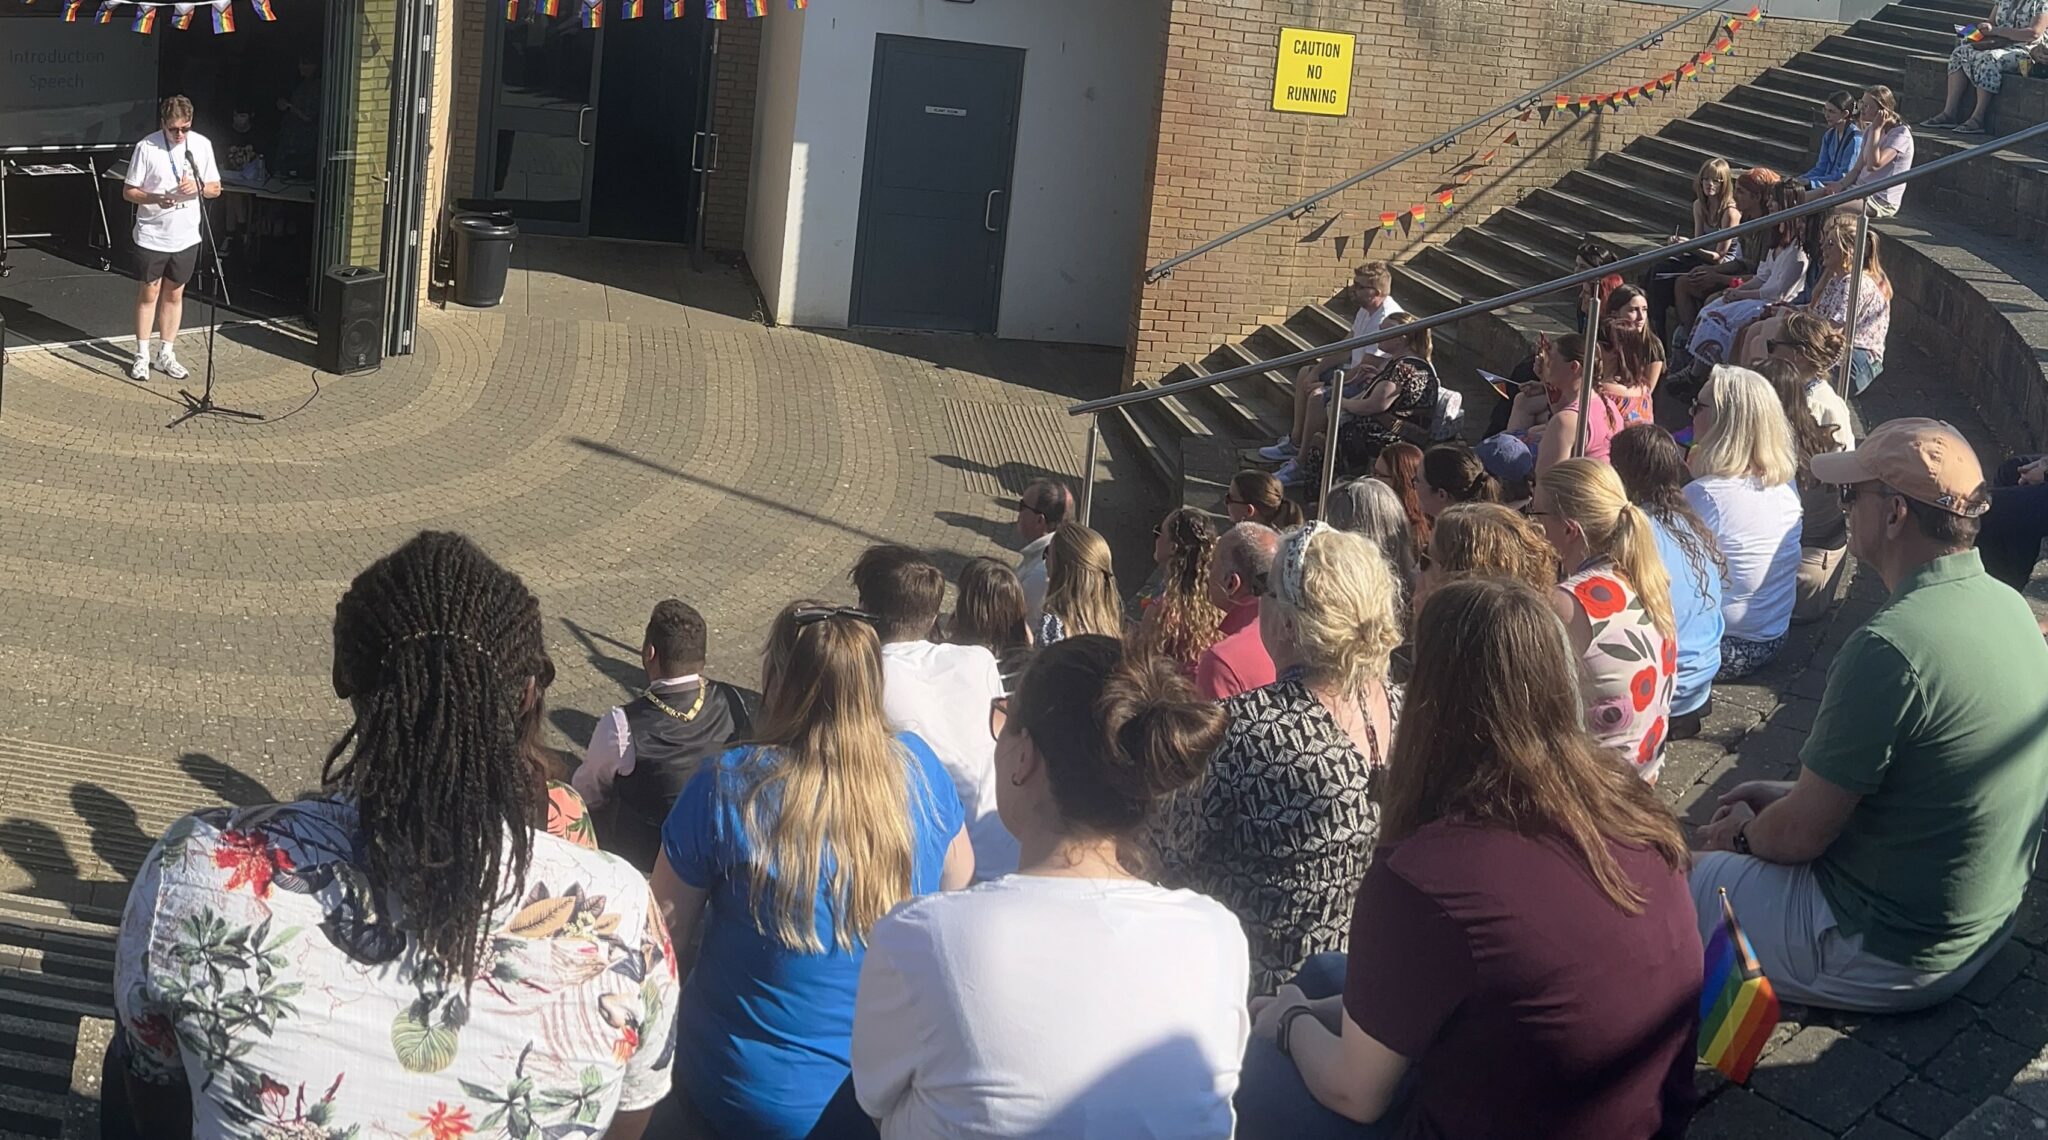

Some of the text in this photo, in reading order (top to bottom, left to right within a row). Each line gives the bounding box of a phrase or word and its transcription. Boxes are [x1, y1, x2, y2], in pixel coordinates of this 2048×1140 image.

[10, 48, 104, 63] Introduction
[1293, 39, 1341, 58] CAUTION
[30, 72, 84, 91] Speech
[1306, 64, 1323, 80] NO
[1286, 85, 1337, 104] RUNNING
